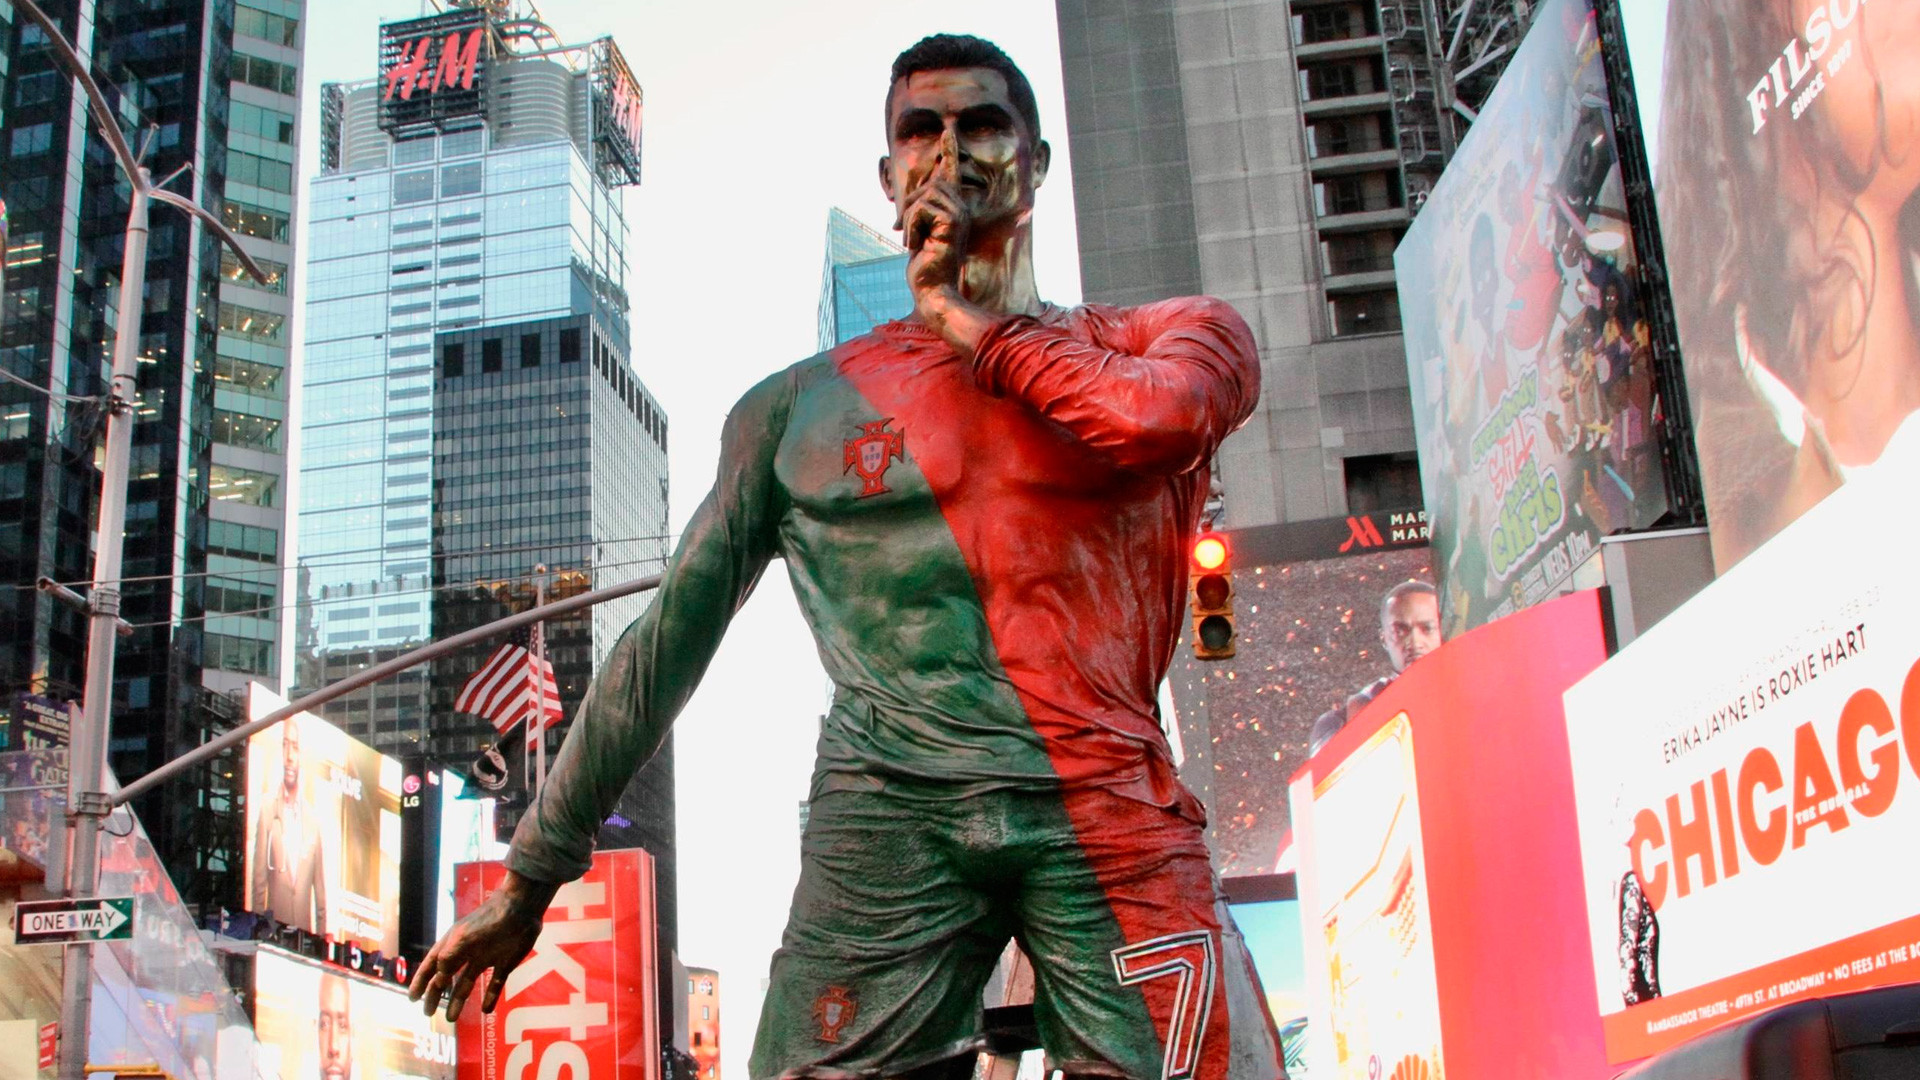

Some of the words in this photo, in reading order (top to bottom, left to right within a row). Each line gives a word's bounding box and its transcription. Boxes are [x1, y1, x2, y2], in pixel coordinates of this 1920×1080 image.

[383, 28, 483, 101] H&M
[1746, 0, 1861, 135] FILSO
[1663, 724, 1702, 764] ERIKA
[1705, 695, 1748, 741] JAYNE
[1752, 685, 1765, 712] IS
[1769, 653, 1818, 702] ROXIE
[1821, 623, 1866, 672] HART
[404, 796, 420, 808] LG
[1795, 805, 1816, 826] THE
[1818, 781, 1871, 815] MUSCAL
[32, 914, 65, 931] ONE
[81, 911, 116, 928] WAY
[1698, 1000, 1728, 1019] THEATRE
[1768, 985, 1778, 1000] AT
[1779, 971, 1825, 997] BROADWAY
[1834, 964, 1850, 981] NO
[1851, 957, 1873, 976] FEES
[1875, 952, 1887, 969] AT
[1888, 946, 1908, 964] THE
[413, 1031, 456, 1067] SOLV
